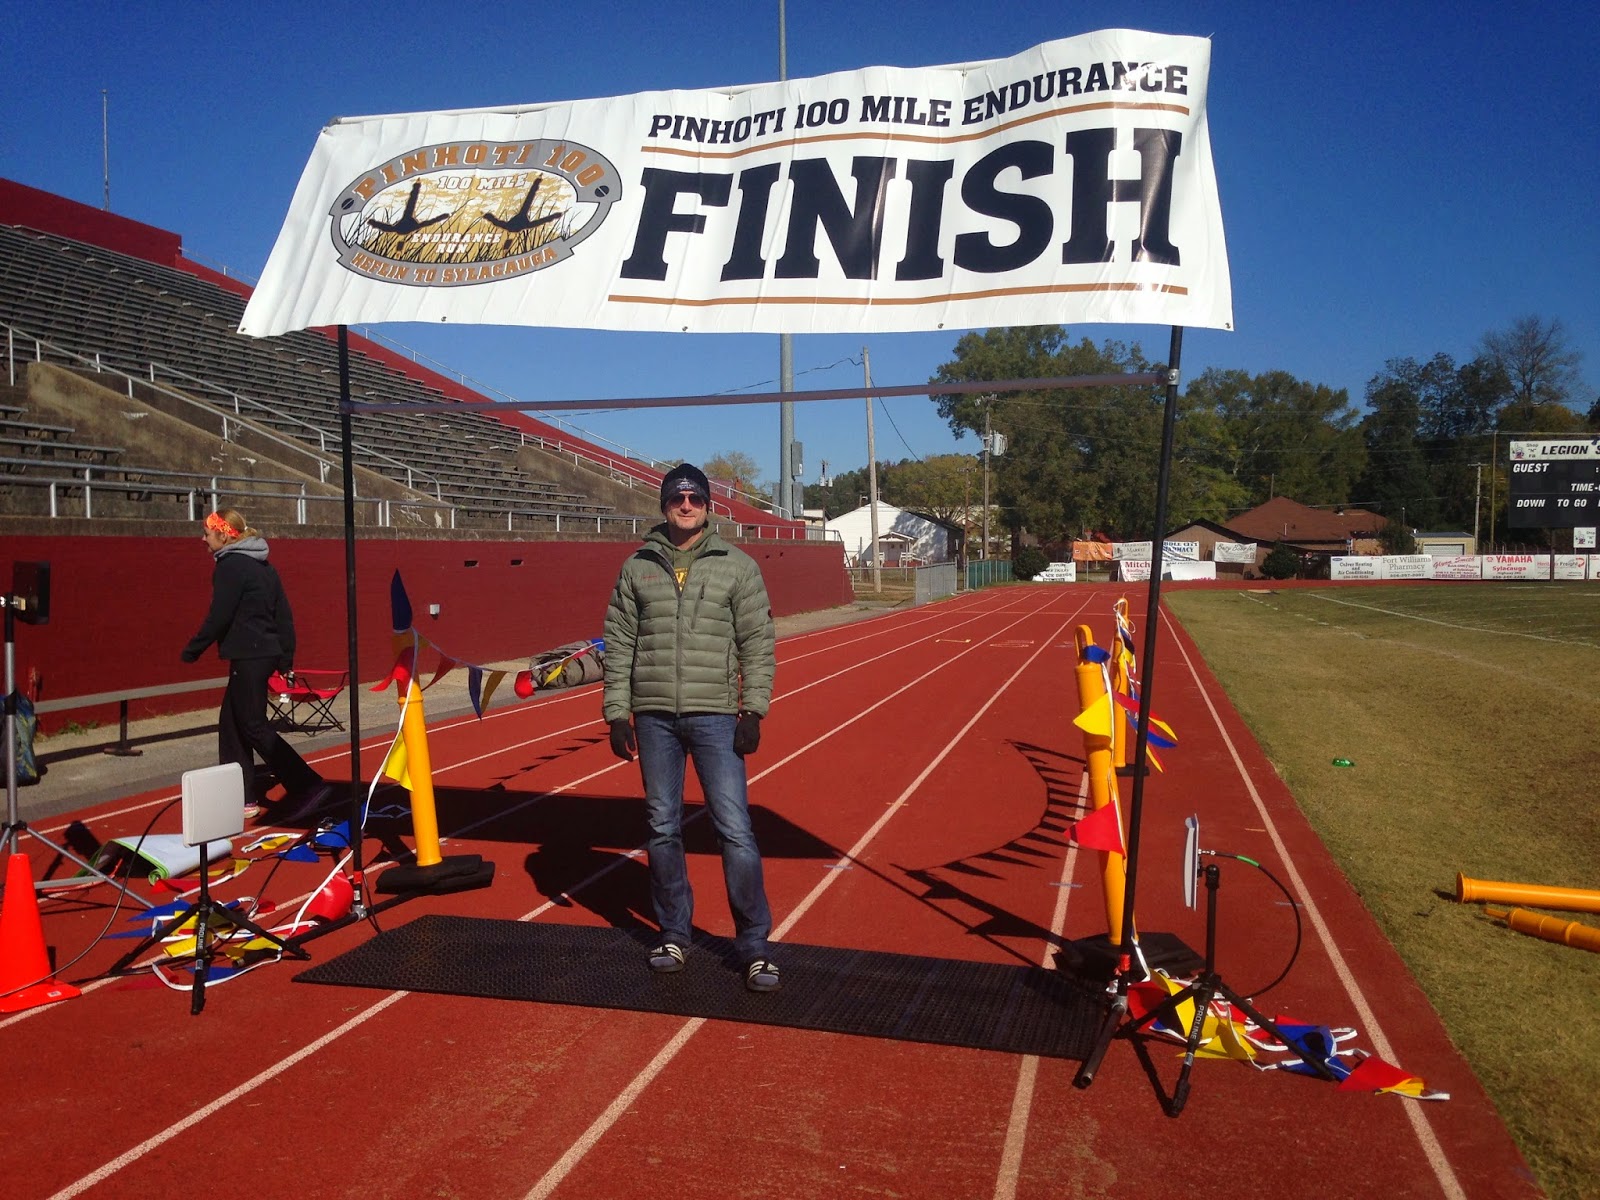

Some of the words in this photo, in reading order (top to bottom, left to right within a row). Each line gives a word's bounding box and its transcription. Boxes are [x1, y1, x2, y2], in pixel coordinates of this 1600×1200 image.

[649, 107, 784, 144] PINHOTI
[795, 98, 850, 129] 100
[860, 95, 952, 127] MILE
[962, 60, 1189, 126] ENDURANCE
[352, 143, 534, 201] PINHOTI
[543, 144, 605, 188] 100
[437, 175, 473, 189] 100
[477, 173, 529, 190] MILE
[620, 127, 1183, 282] FINISH
[411, 233, 503, 244] ENDURANCE
[435, 243, 469, 254] RUN
[413, 268, 437, 283] TO
[1541, 445, 1589, 455] LEGION
[1513, 463, 1550, 473] GUEST
[1516, 499, 1546, 508] DOWN
[1557, 499, 1570, 507] TO
[1573, 499, 1587, 507] GO
[197, 922, 206, 950] PROLINE
[1191, 1005, 1205, 1040] PROLINE
